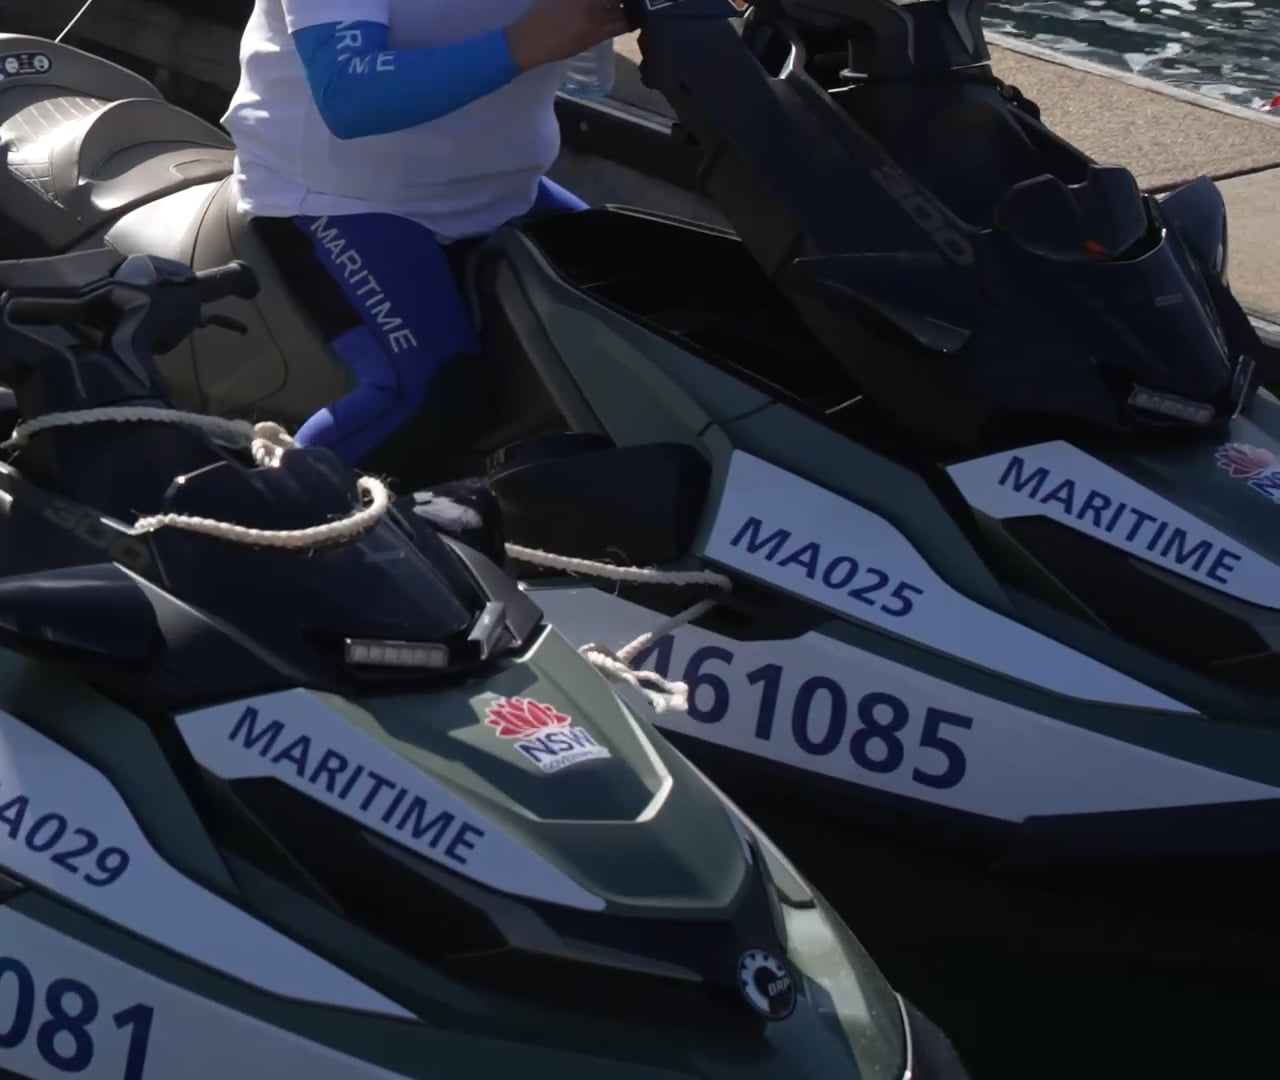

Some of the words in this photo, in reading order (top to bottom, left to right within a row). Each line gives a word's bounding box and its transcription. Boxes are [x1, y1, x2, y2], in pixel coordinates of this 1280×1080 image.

[310, 216, 417, 353] MARITIME
[730, 516, 924, 617] MA025
[998, 455, 1242, 584] MARITIME
[518, 728, 594, 762] NSW
[628, 633, 974, 790] 461085
[228, 705, 485, 864] MARITIME
